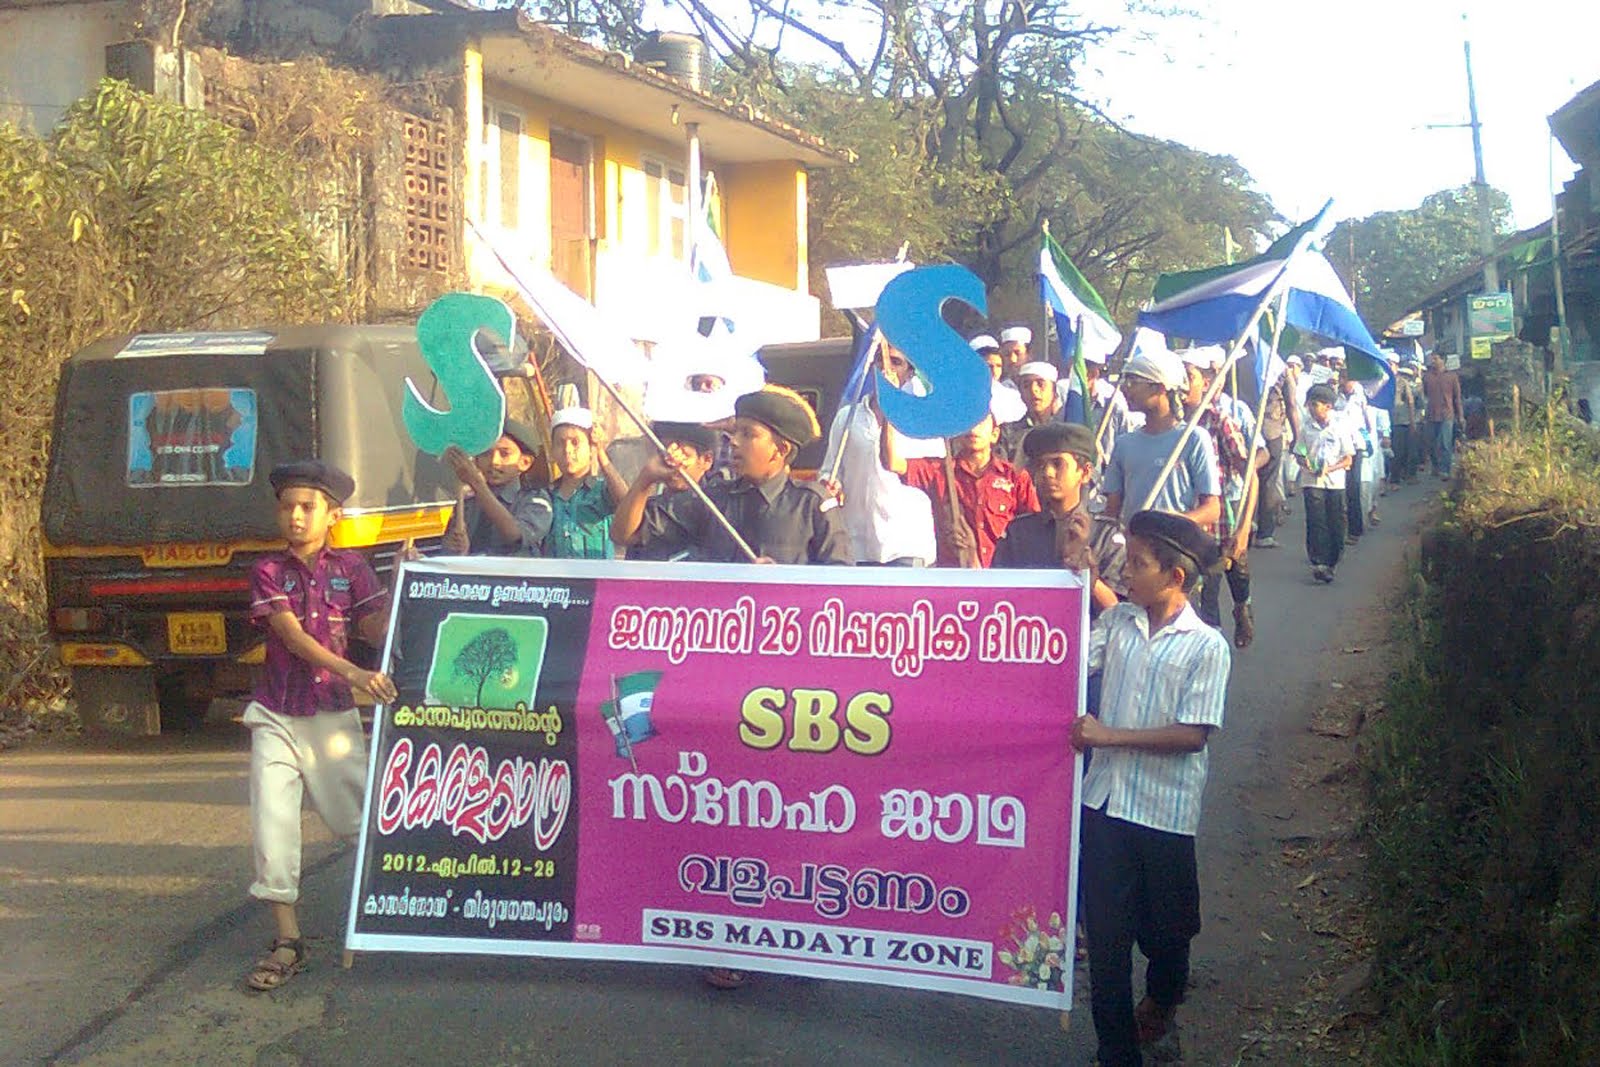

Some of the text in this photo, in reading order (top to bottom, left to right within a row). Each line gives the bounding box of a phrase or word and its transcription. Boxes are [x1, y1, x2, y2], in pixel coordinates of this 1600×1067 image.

[402, 291, 516, 456] S
[875, 264, 991, 439] S
[608, 596, 1067, 677] ജനുവരി 26 റിപ്പബ്ലിക് ദിനം
[738, 686, 893, 755] SBS
[378, 738, 571, 851] കേരളയാത്ര
[608, 752, 1026, 848] സ്നേഹ ജാഥ
[679, 853, 970, 918] വളപട്ടണം
[651, 916, 984, 970] SBS MADAYI ZONE
